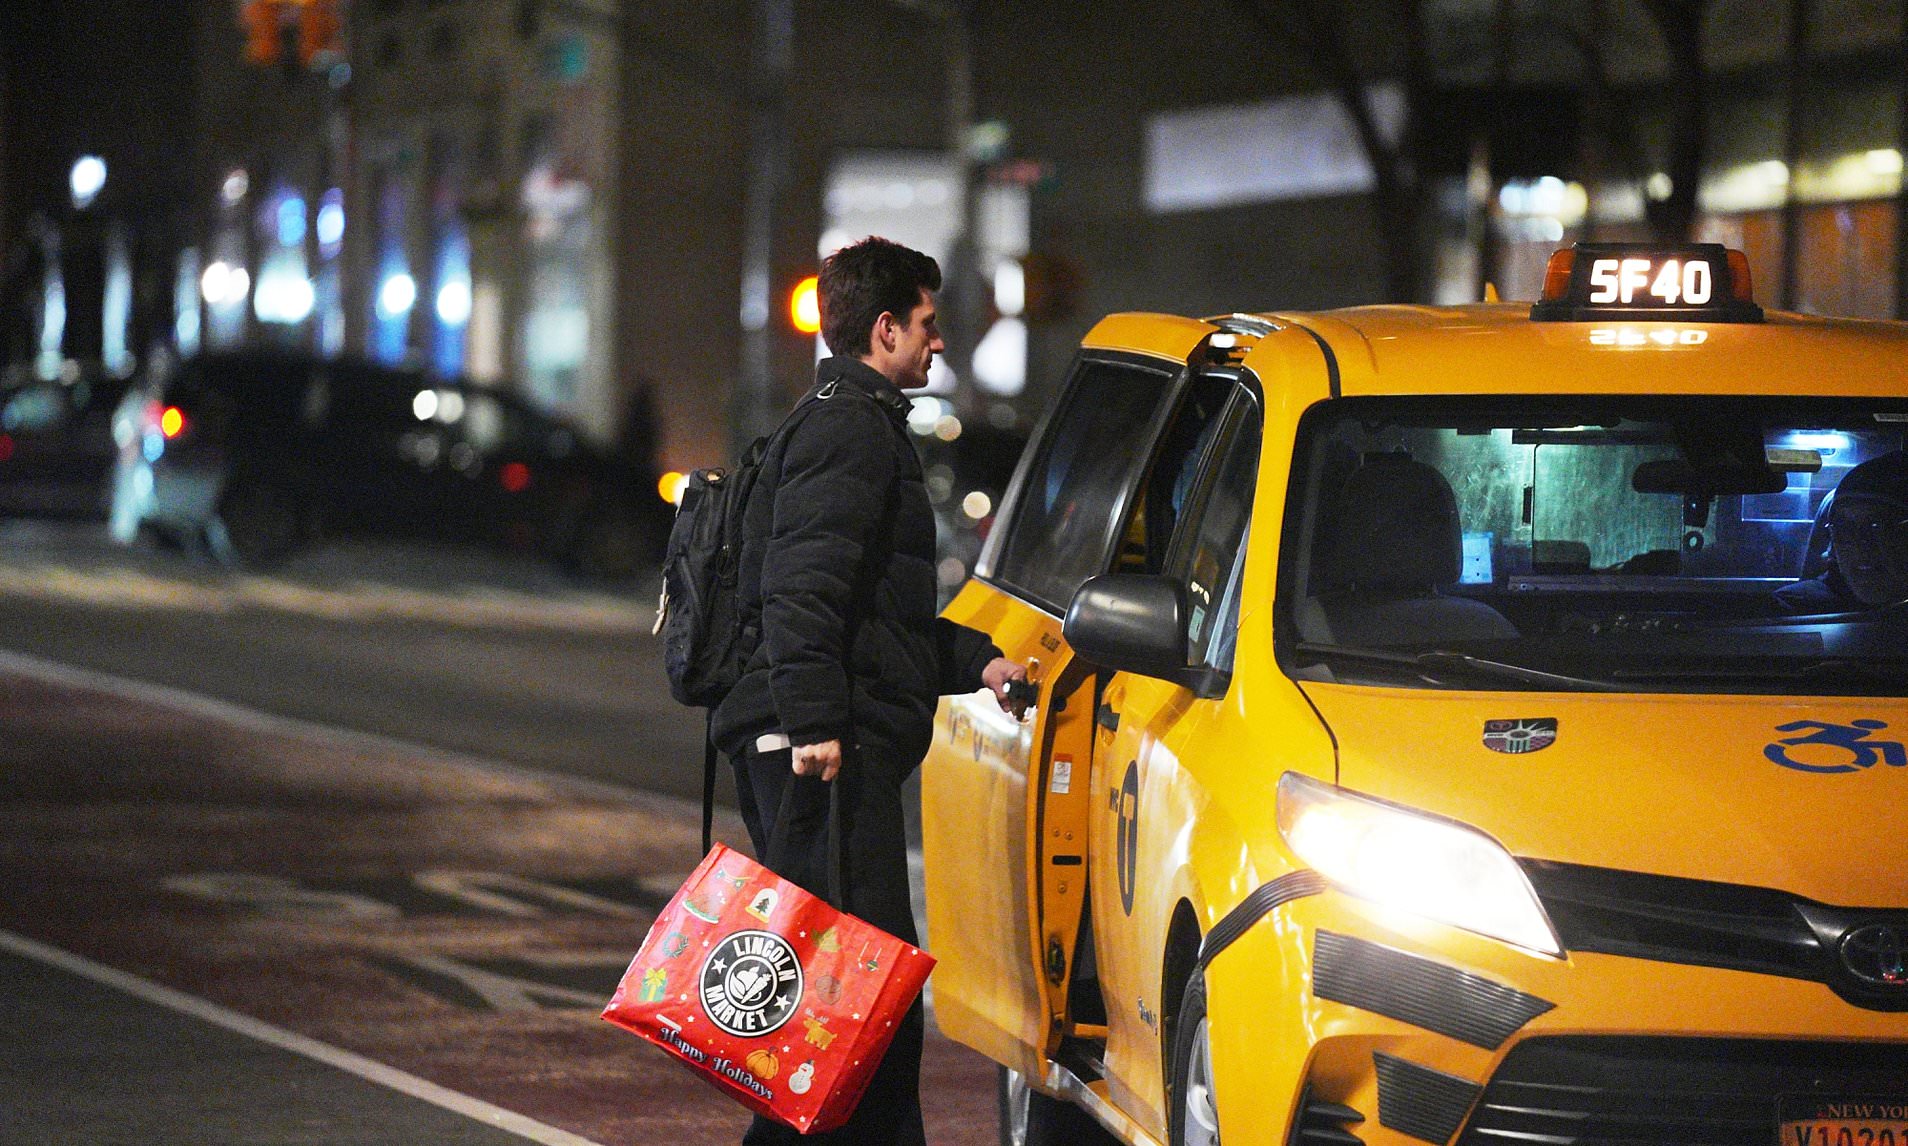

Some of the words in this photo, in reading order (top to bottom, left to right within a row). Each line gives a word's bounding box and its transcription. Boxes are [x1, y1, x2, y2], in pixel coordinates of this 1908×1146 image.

[732, 936, 797, 982] LINCOLN
[705, 984, 768, 1030] MARKET
[661, 1027, 708, 1063] Happy
[713, 1057, 773, 1100] Holidays
[1827, 1104, 1873, 1118] NEW
